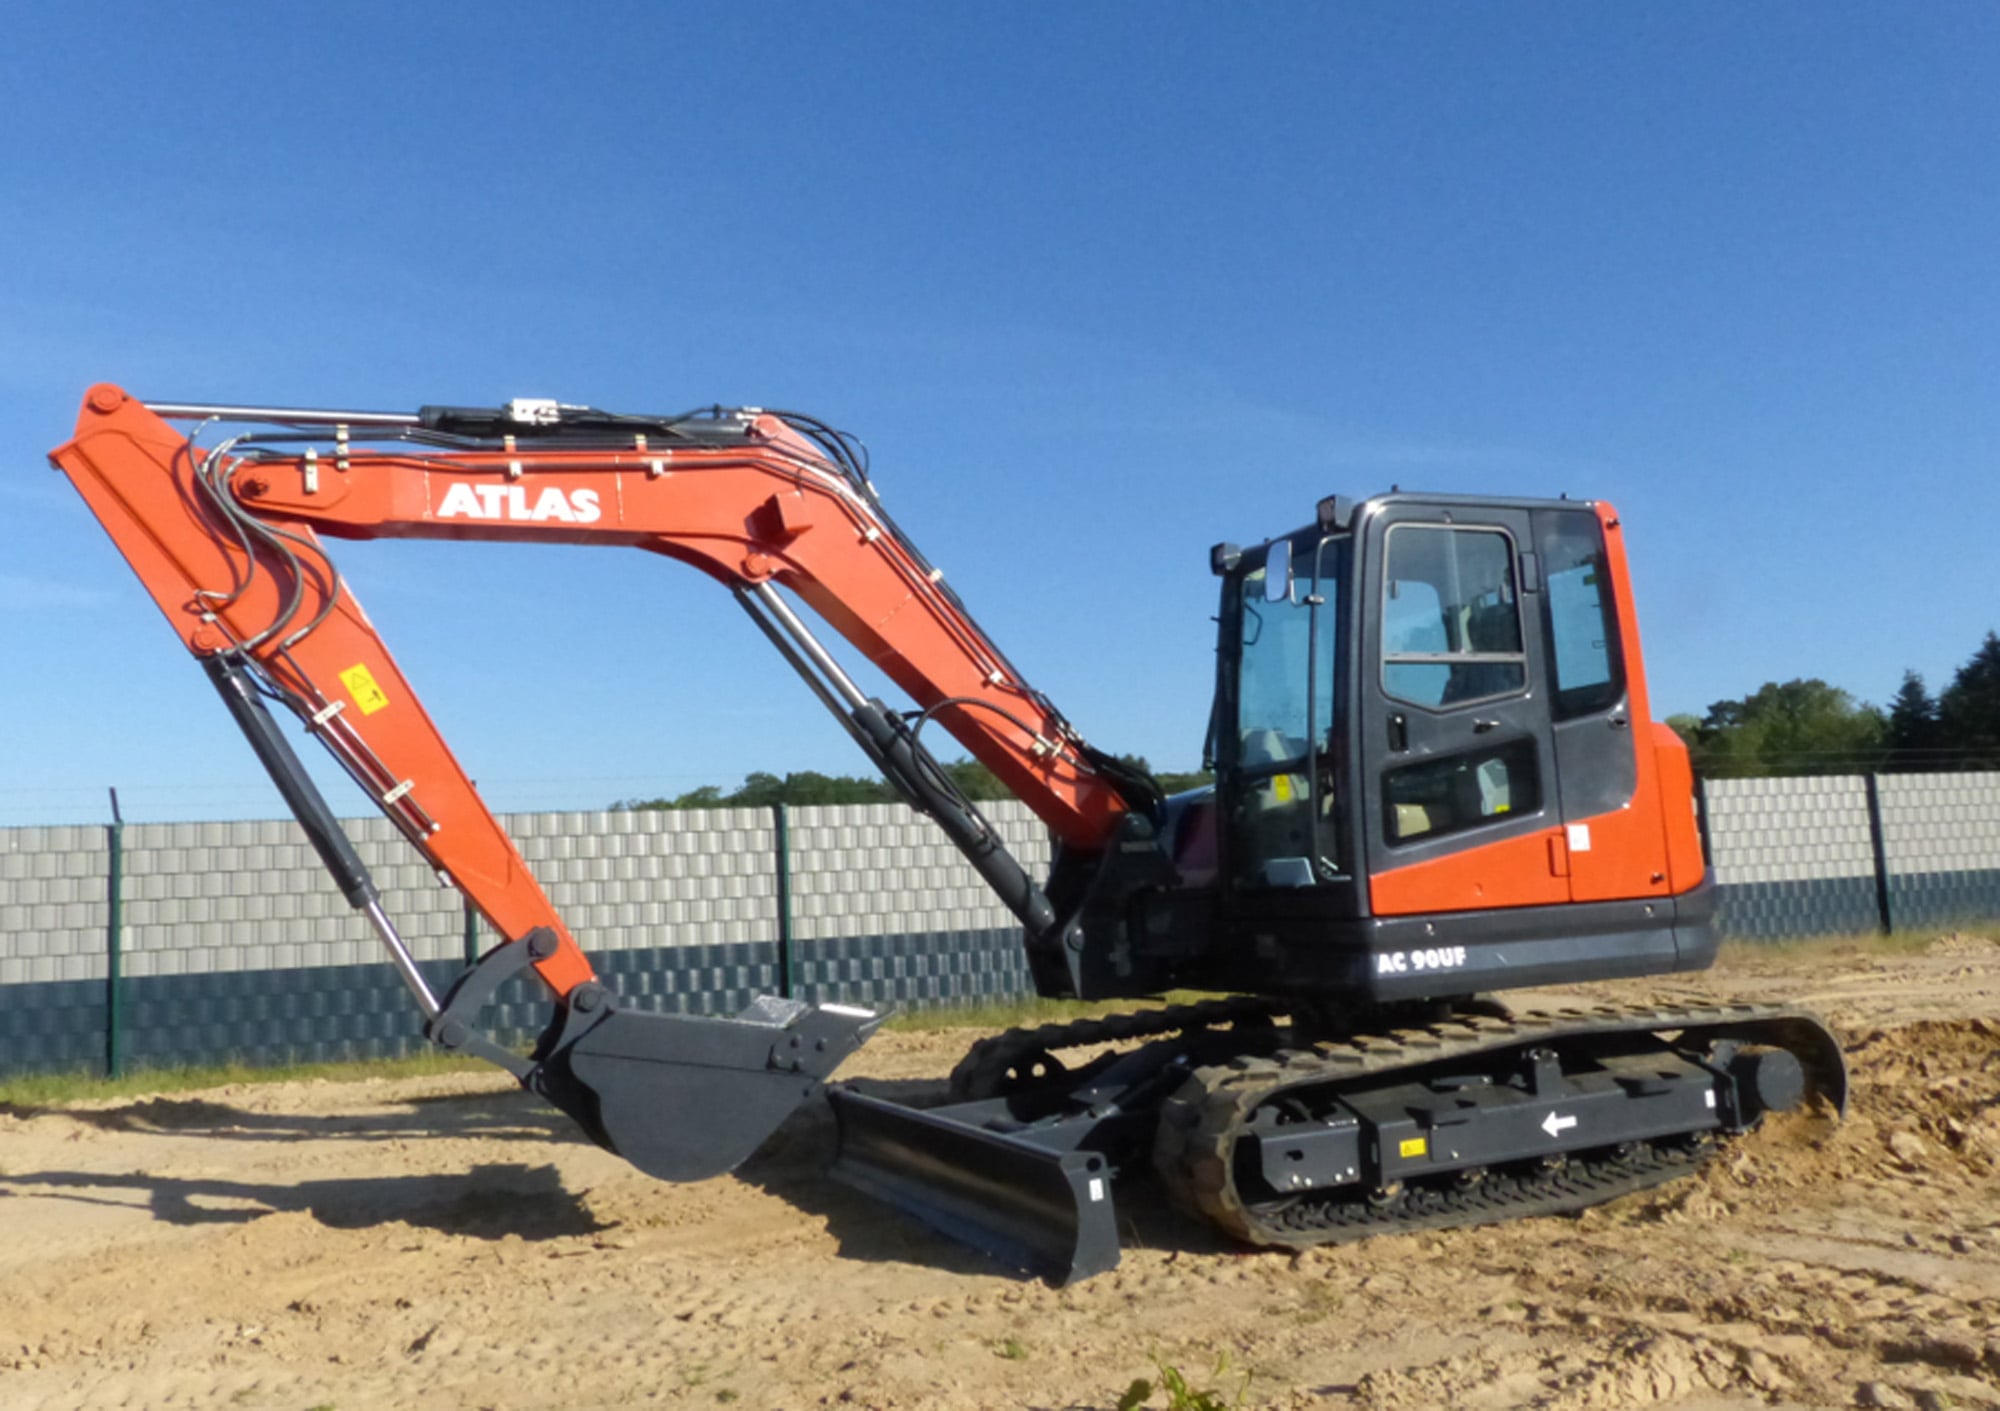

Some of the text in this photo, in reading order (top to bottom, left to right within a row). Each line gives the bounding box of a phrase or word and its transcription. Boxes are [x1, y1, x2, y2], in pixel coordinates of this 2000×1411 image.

[437, 483, 601, 523] ATLAS
[1378, 946, 1466, 973] AC 90UF
